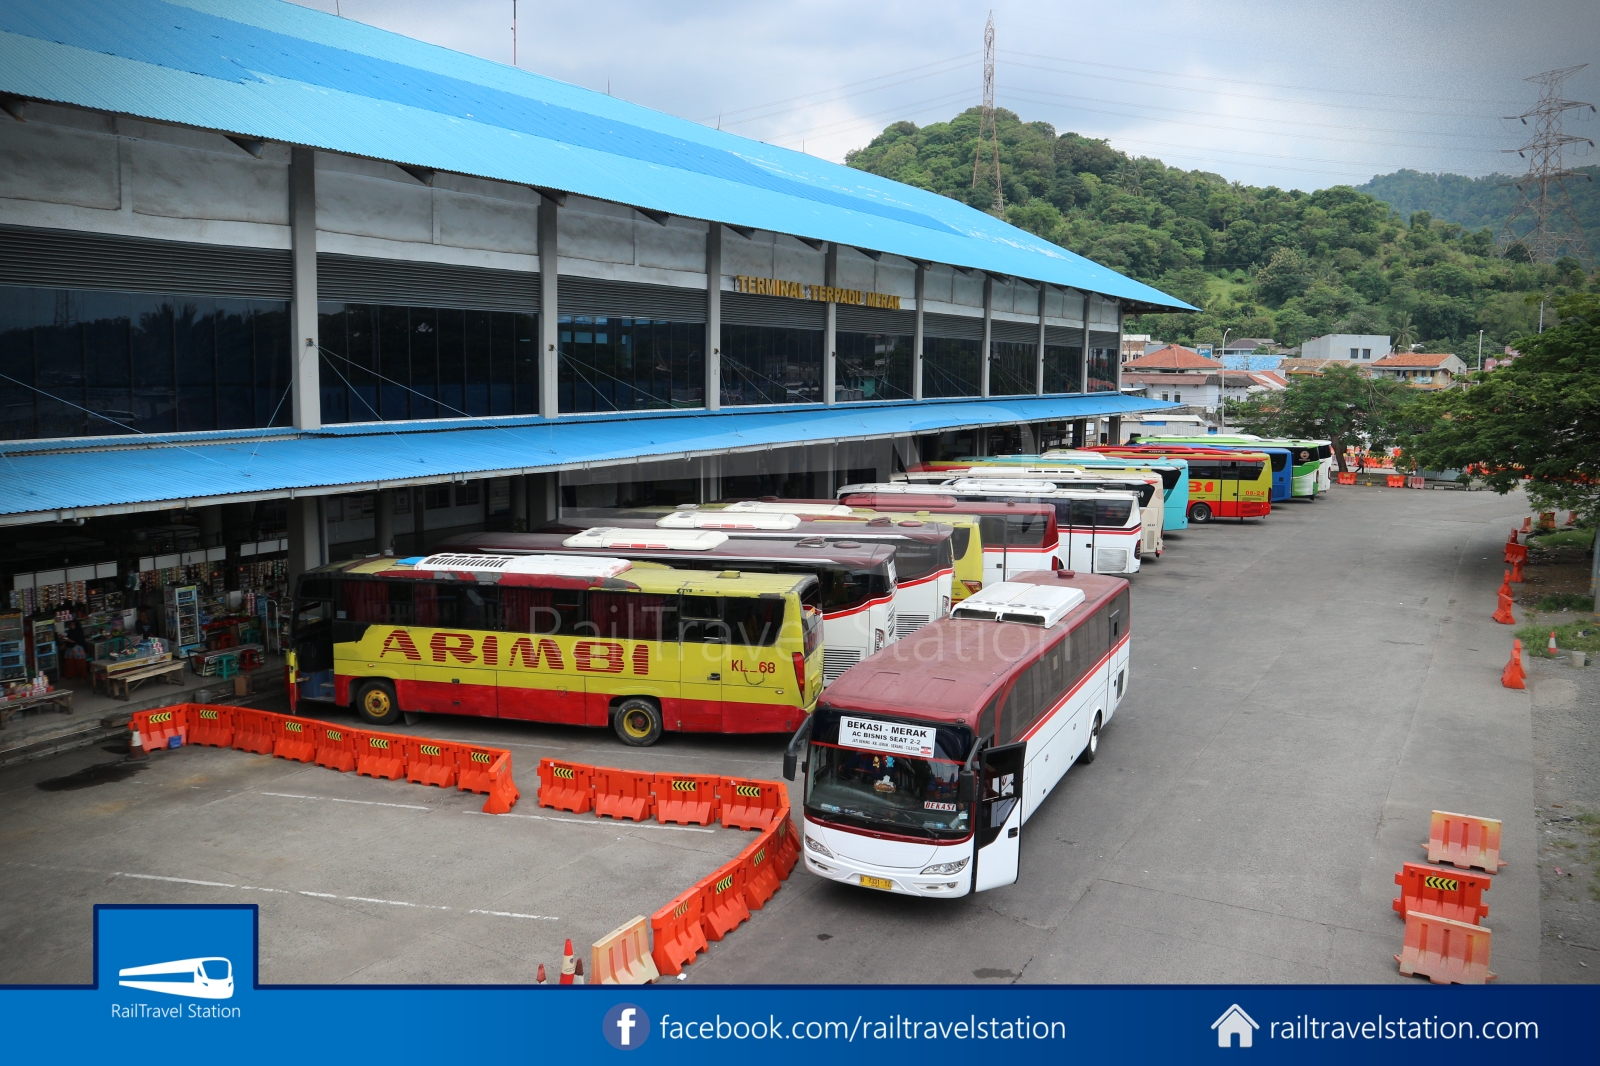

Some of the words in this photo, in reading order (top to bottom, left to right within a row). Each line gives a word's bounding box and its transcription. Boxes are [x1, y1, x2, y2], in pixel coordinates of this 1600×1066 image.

[737, 275, 805, 299] TERMINAL
[809, 285, 863, 305] TERPADU
[866, 291, 901, 310] MERAK
[379, 629, 650, 676] ARIMBI
[847, 720, 883, 732] BEKASI
[891, 726, 927, 738] MERAK
[863, 732, 888, 741] BISNIS
[889, 735, 908, 744] SEAT
[925, 802, 956, 811] BEKASI
